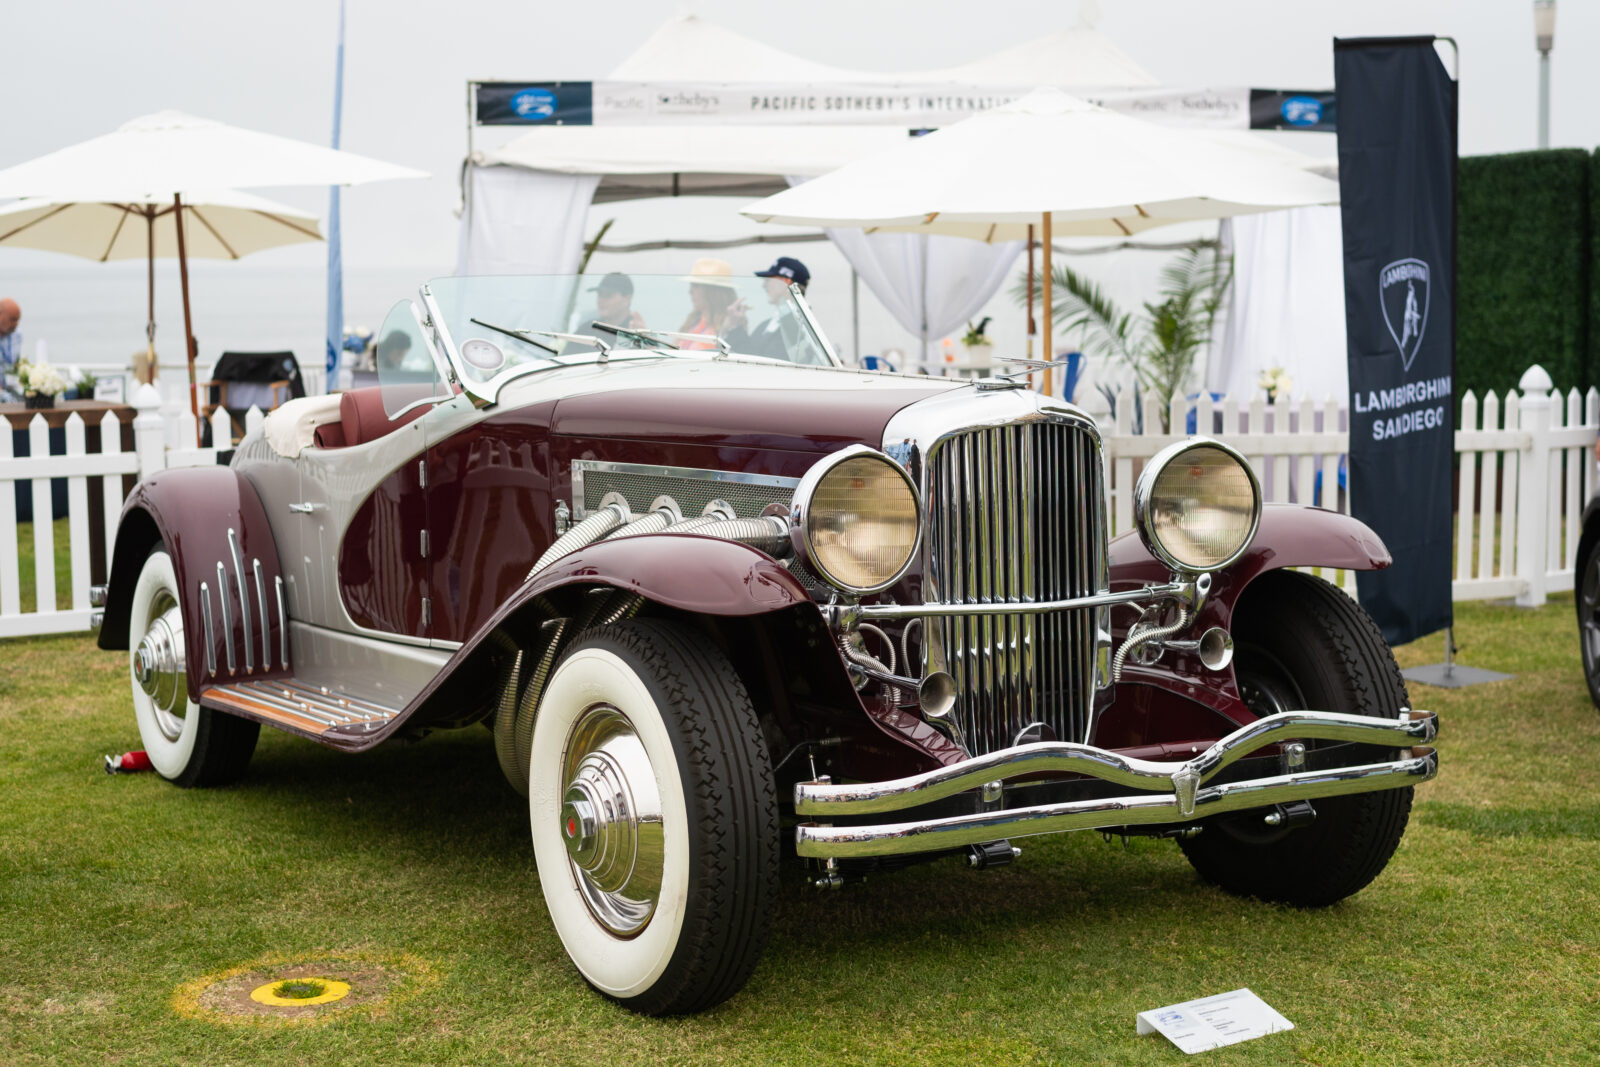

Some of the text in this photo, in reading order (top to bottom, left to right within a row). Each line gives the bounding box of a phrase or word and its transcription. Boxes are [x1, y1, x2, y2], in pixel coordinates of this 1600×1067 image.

[656, 92, 720, 108] Stheby's
[751, 96, 816, 110] PACIFIC
[825, 96, 910, 111] SOTHEBY'S
